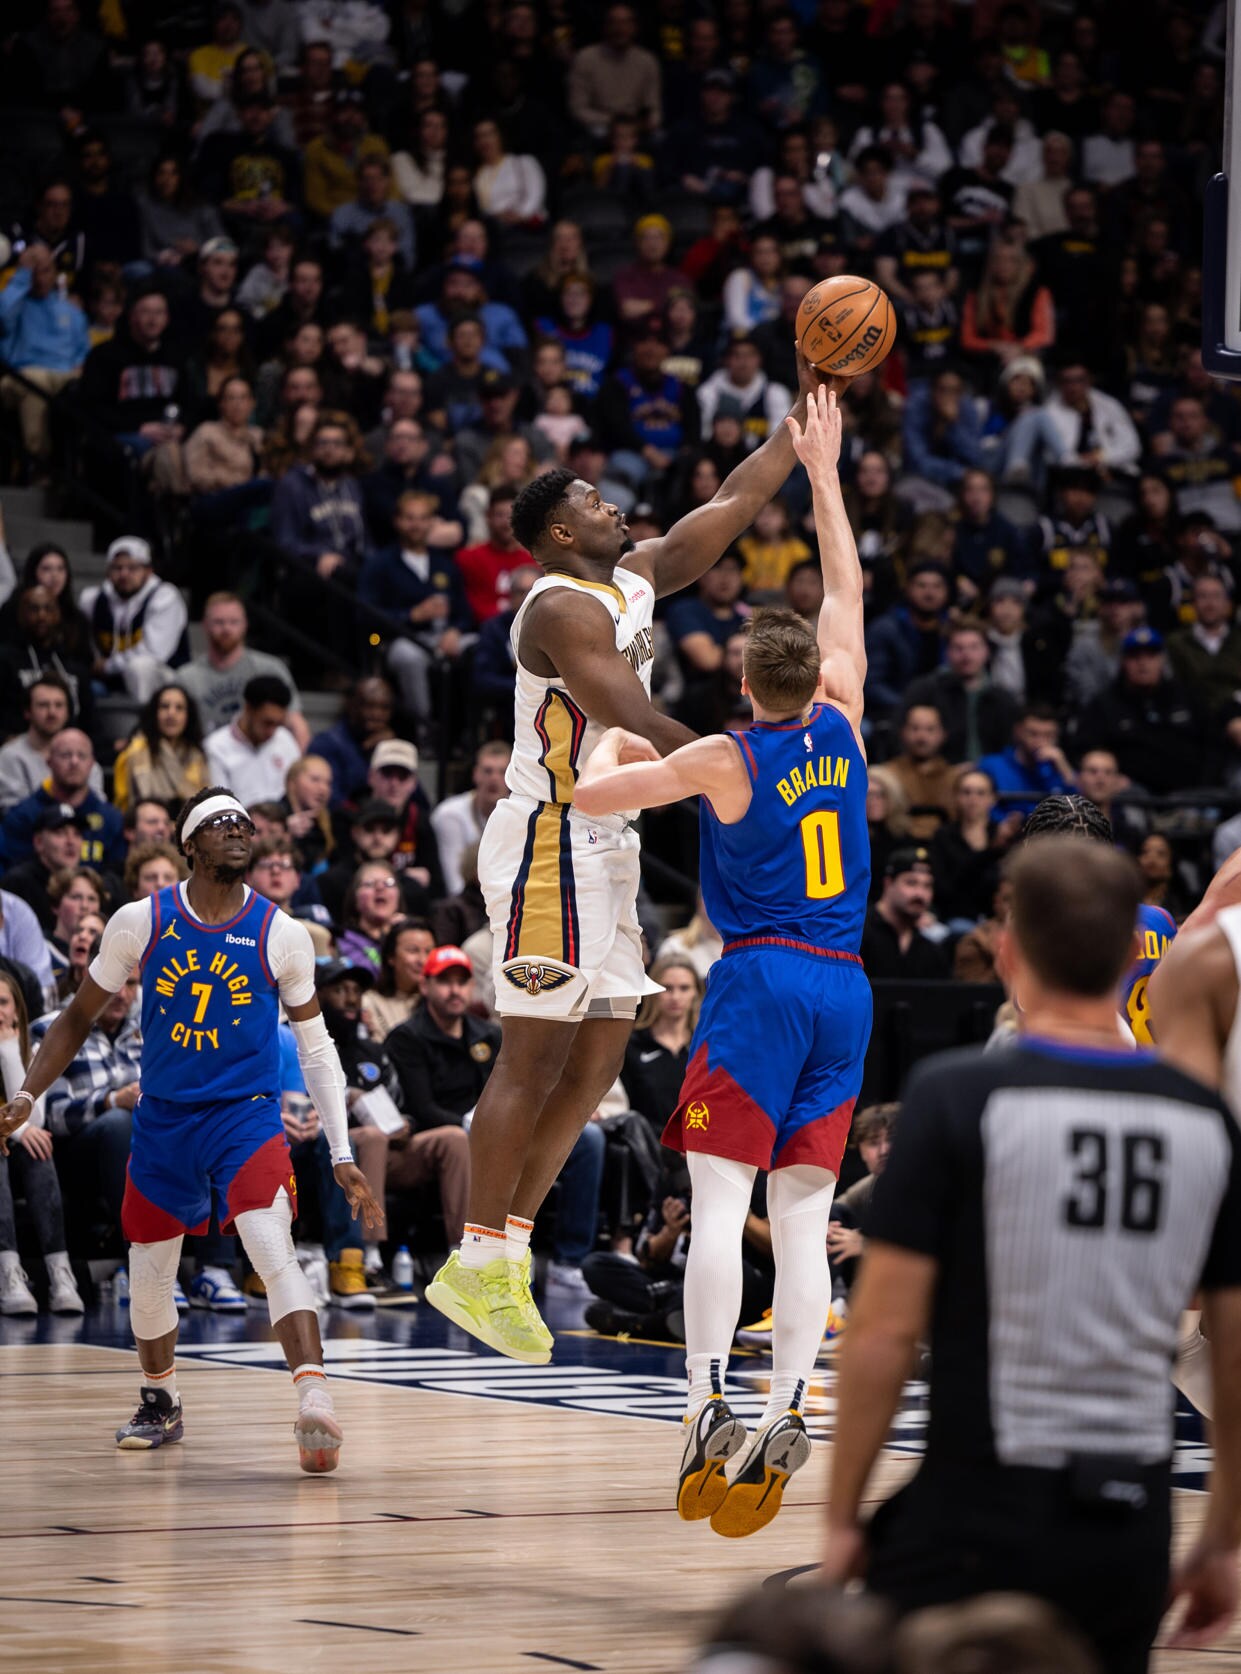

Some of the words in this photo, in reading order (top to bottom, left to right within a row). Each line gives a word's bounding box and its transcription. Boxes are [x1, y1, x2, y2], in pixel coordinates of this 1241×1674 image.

[827, 325, 882, 371] Wilson
[776, 755, 850, 807] BRAUN
[800, 809, 846, 899] 0
[225, 933, 256, 947] ibotta
[155, 949, 201, 998] MILE
[208, 951, 253, 1006] HIGH
[191, 981, 214, 1024] 7
[170, 1021, 220, 1052] CITY
[1065, 1128, 1164, 1233] 36
